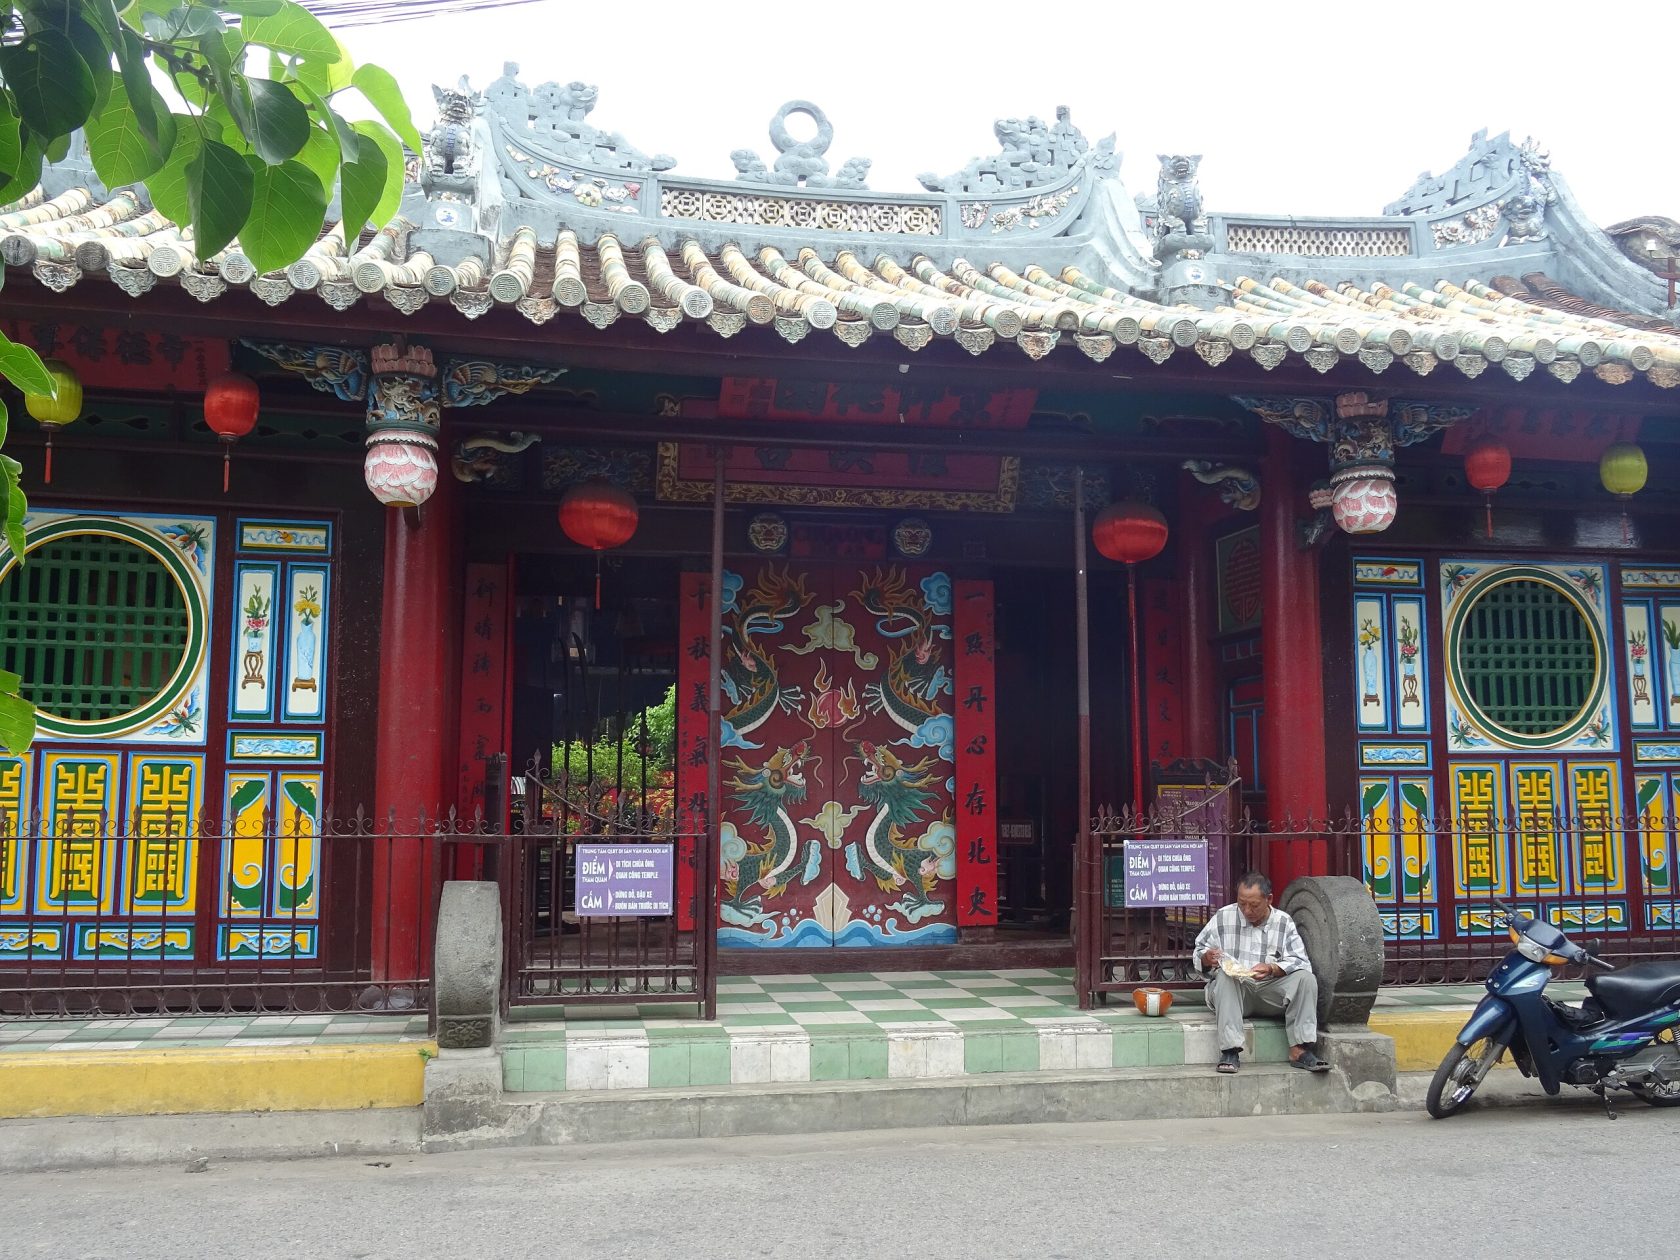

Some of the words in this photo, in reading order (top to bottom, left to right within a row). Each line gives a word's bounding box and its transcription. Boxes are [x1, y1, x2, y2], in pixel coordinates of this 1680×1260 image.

[582, 856, 605, 874] ĐIỂM
[1129, 851, 1149, 868] ĐIỂM
[582, 891, 602, 908] CẤM
[1130, 884, 1147, 900] CẤM
